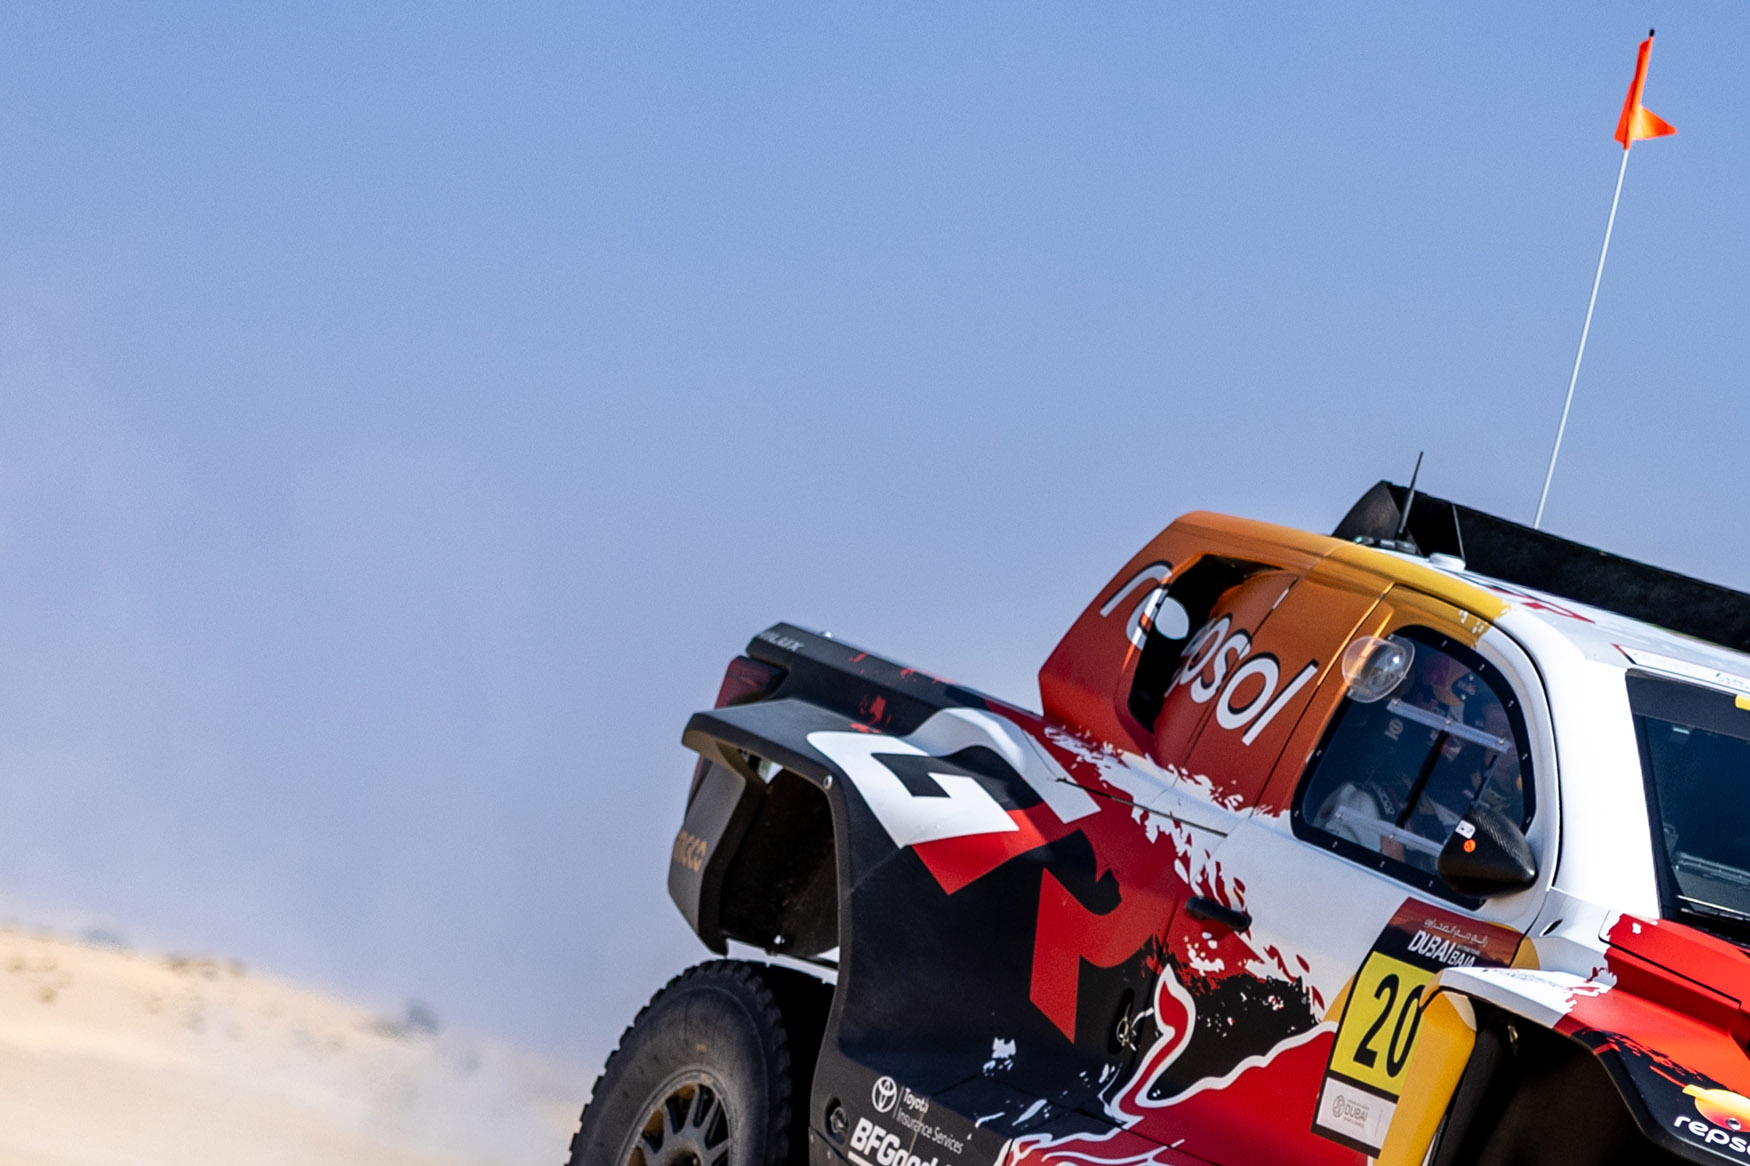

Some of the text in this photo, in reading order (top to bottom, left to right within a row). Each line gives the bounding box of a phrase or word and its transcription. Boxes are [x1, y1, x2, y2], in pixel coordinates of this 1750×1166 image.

[1407, 929, 1457, 963] DUBAI
[903, 1087, 930, 1114] Toyota
[1344, 1104, 1369, 1122] DUBAI
[896, 1107, 964, 1155] Insurance Services
